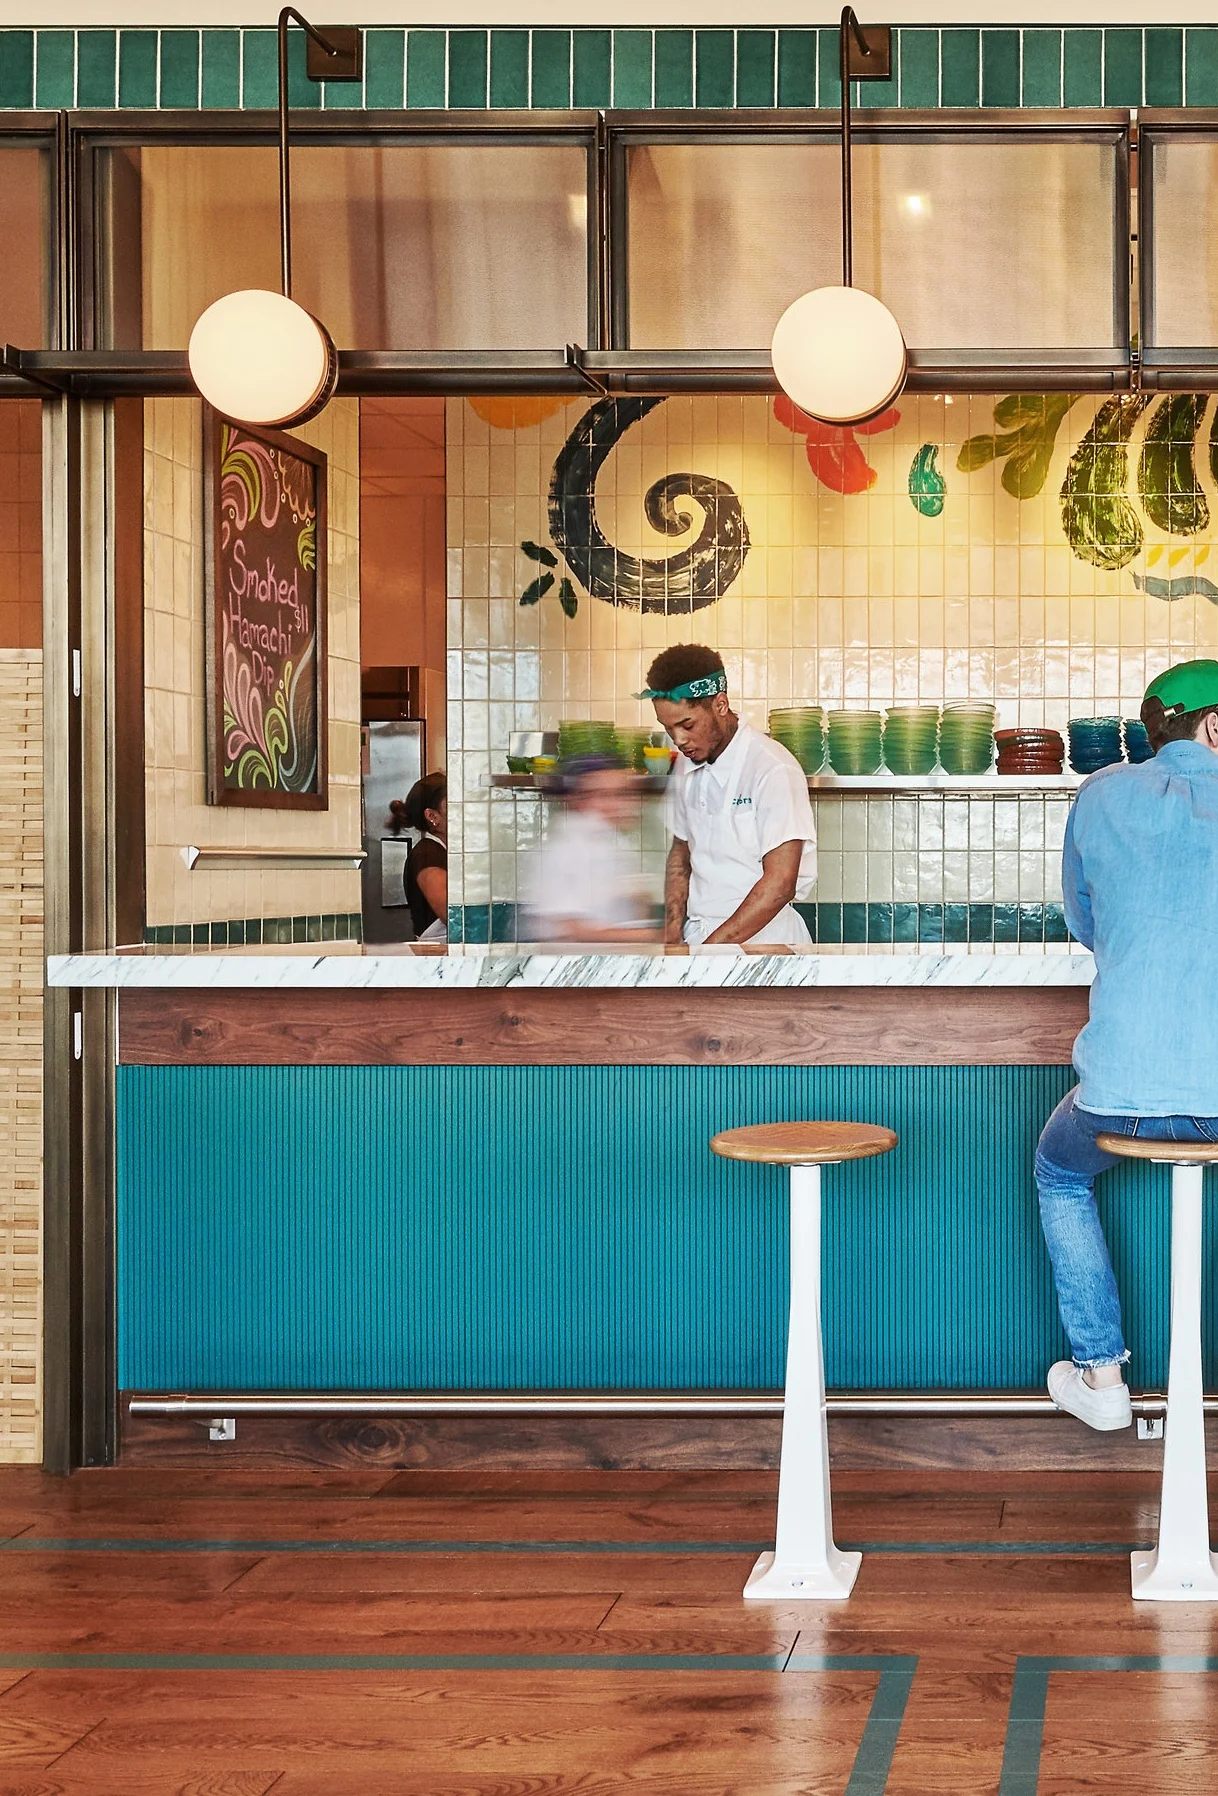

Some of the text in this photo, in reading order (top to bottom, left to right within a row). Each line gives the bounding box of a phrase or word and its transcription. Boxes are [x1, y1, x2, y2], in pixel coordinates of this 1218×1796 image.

[229, 539, 299, 608] Smoked
[229, 592, 309, 656] Hamachi $11
[252, 651, 275, 696] Dip
